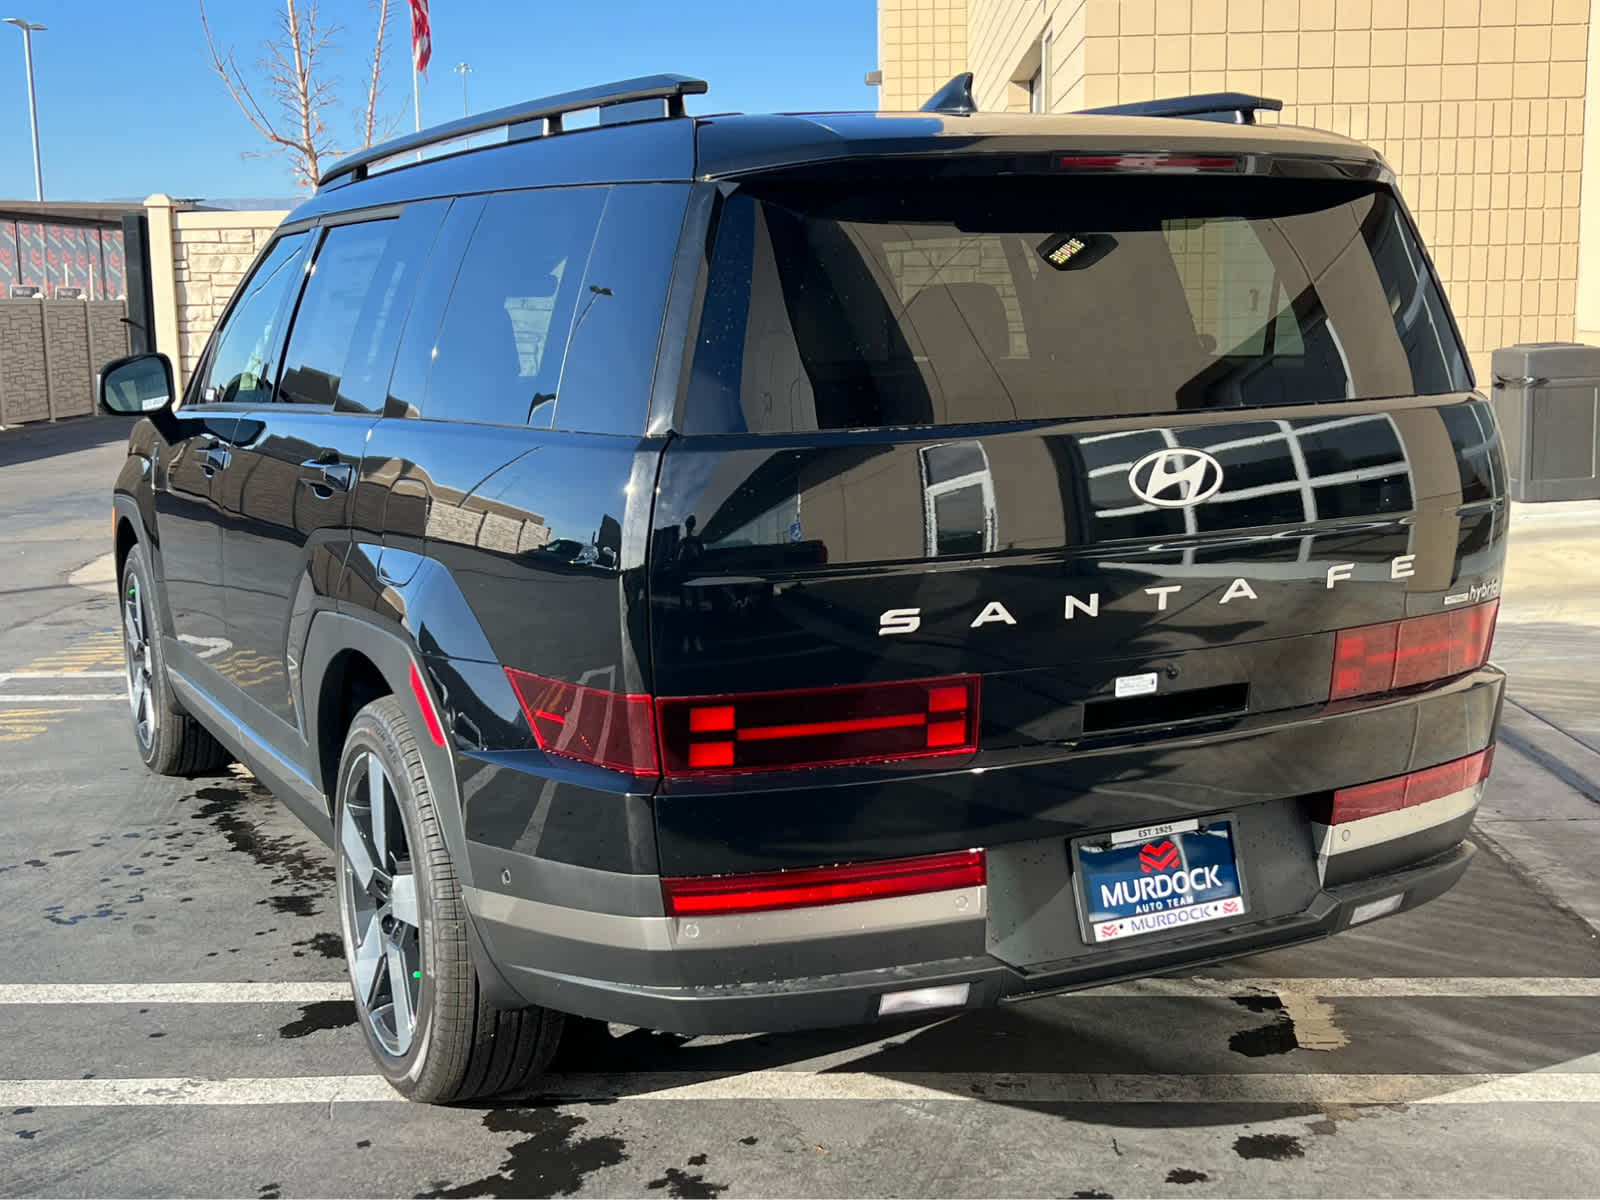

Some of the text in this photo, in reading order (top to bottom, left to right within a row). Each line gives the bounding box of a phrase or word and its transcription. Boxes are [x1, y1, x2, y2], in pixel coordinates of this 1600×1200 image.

[878, 554, 1416, 636] SANTA FE
[1468, 578, 1498, 603] hybrid
[1155, 825, 1173, 836] 1925
[1100, 864, 1223, 908] MURDOCK
[1135, 895, 1195, 914] AUTO TEAM
[1130, 904, 1211, 933] MURDOCK
